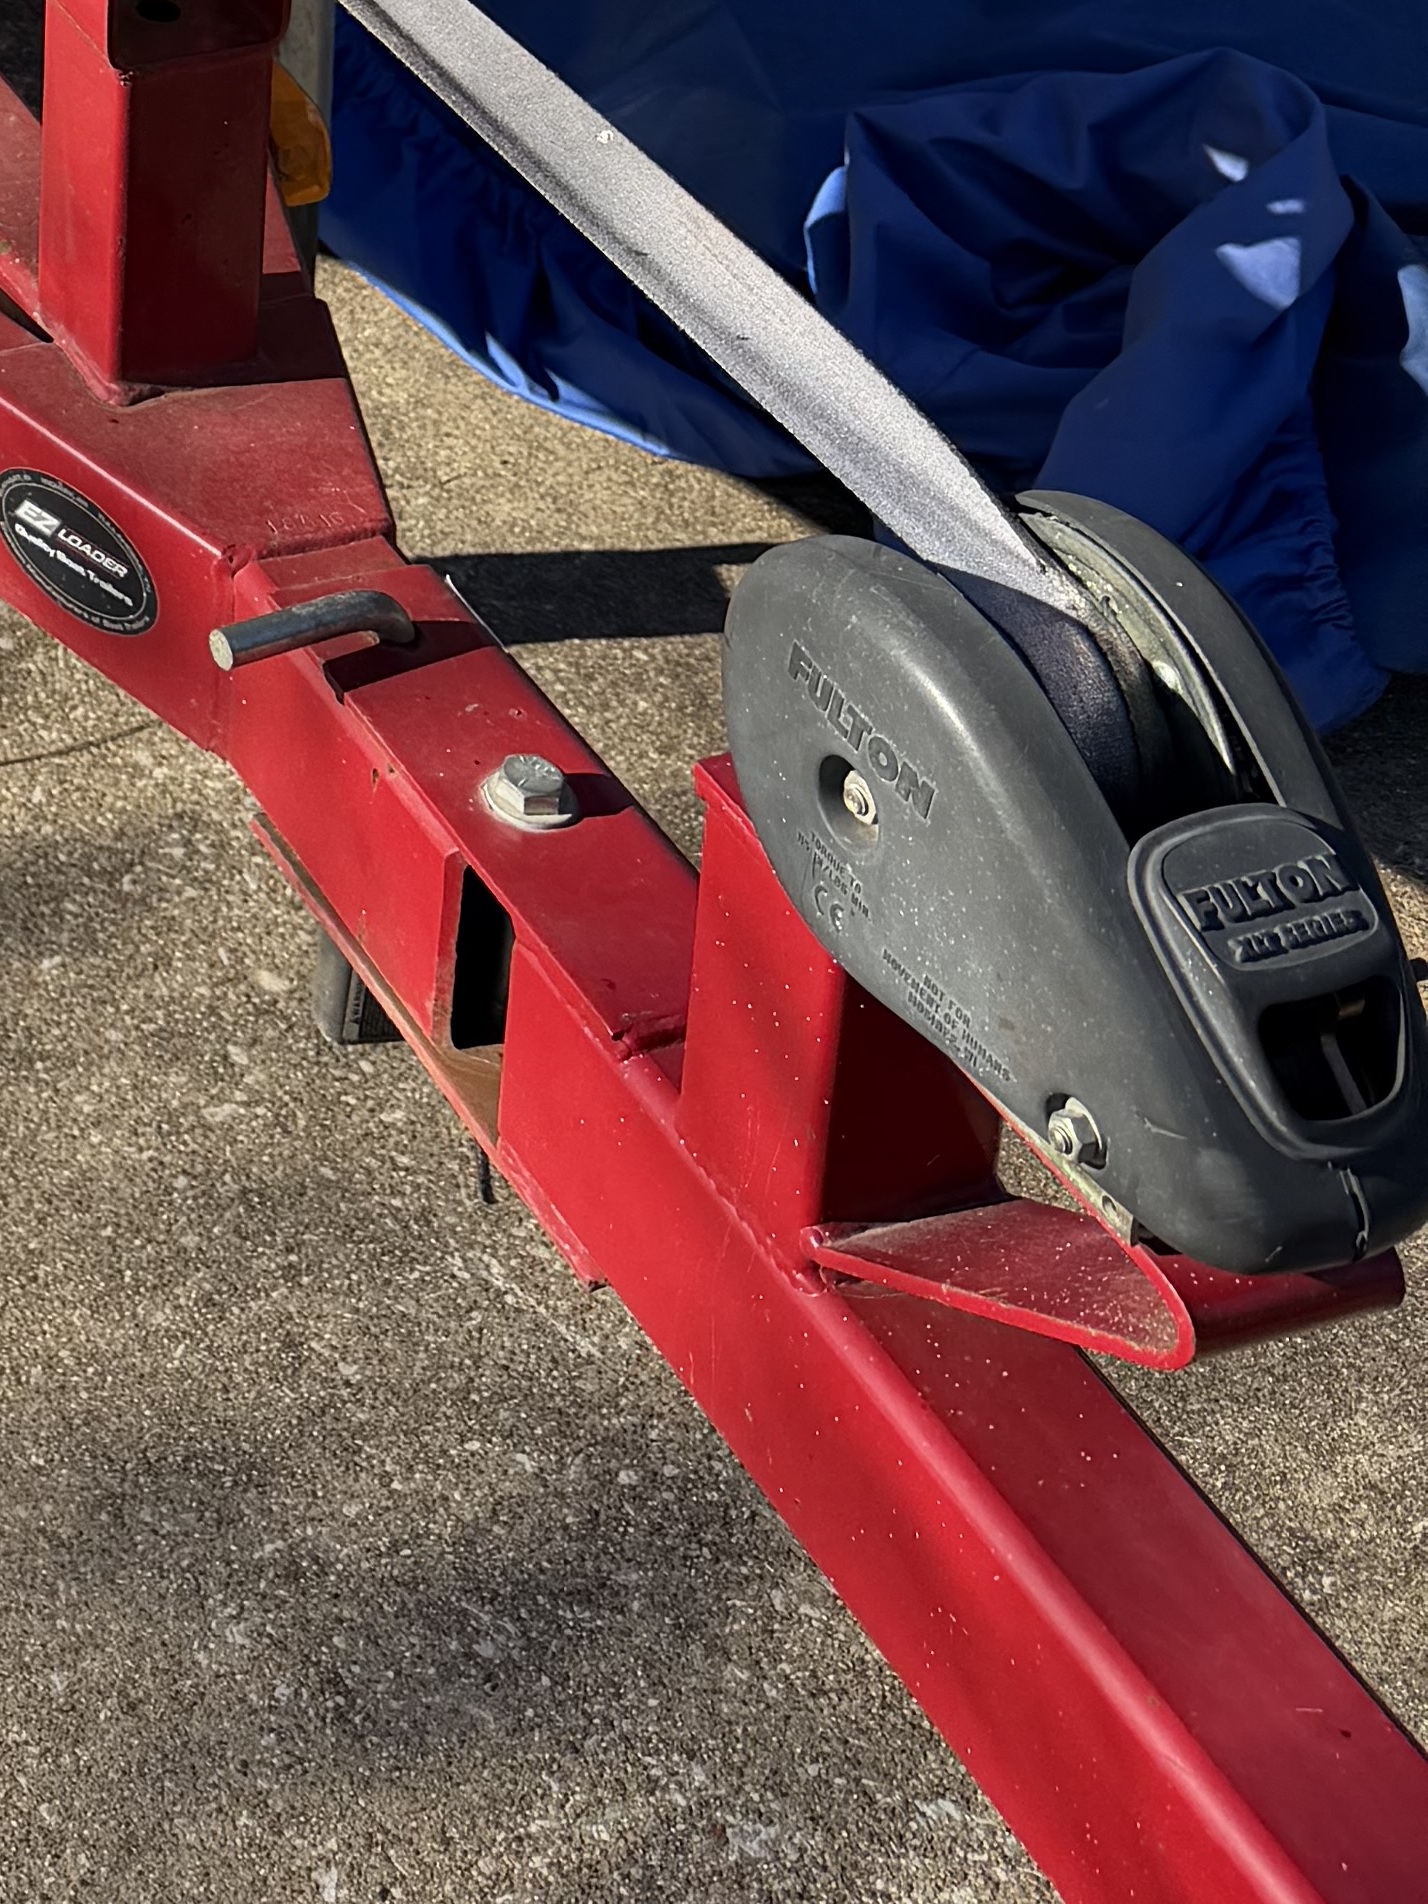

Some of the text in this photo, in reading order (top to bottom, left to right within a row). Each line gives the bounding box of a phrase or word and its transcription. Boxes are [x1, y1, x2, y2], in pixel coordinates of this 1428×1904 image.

[14, 499, 62, 537] EZ
[57, 528, 129, 578] LOADER
[787, 639, 937, 820] FULTON
[1176, 854, 1358, 932] FULTON
[1274, 908, 1370, 950] SERIES
[882, 948, 1011, 1082] MOVEMENT OF HUMANS
[923, 974, 972, 1029] NOT FOR
